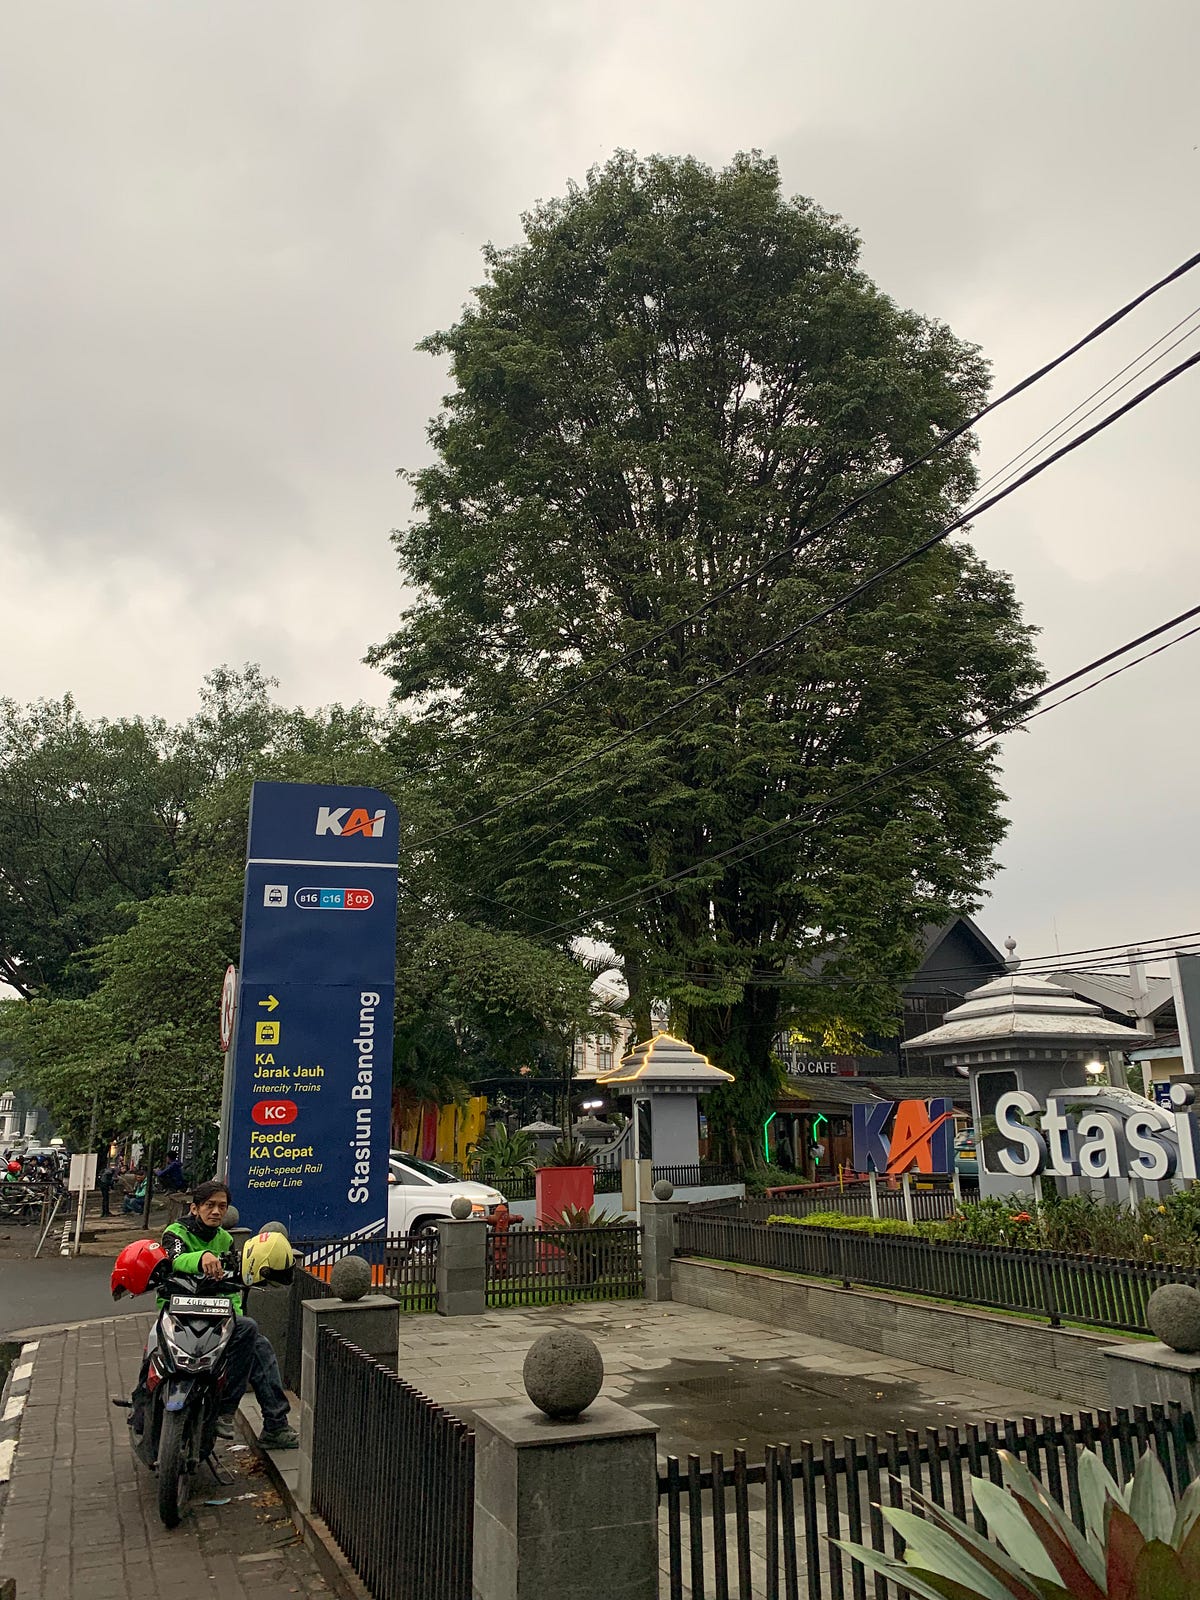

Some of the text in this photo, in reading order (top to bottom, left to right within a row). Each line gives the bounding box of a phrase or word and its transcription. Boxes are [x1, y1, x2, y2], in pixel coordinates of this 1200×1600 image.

[315, 806, 386, 838] KAI
[300, 893, 318, 903] B16
[322, 894, 341, 904] C16
[255, 1053, 275, 1065] KA
[253, 1065, 325, 1078] Jarak Jauh
[807, 1061, 838, 1074] CAFE
[252, 1082, 322, 1094] Intercity Trains
[347, 991, 381, 1204] Stasiun Bandung
[264, 1106, 287, 1120] KC
[251, 1130, 297, 1144] Feeder
[852, 1097, 955, 1175] KAI
[249, 1145, 314, 1160] KA Cepat
[248, 1163, 323, 1177] High-speed Rail
[247, 1177, 303, 1189] Feeder Line
